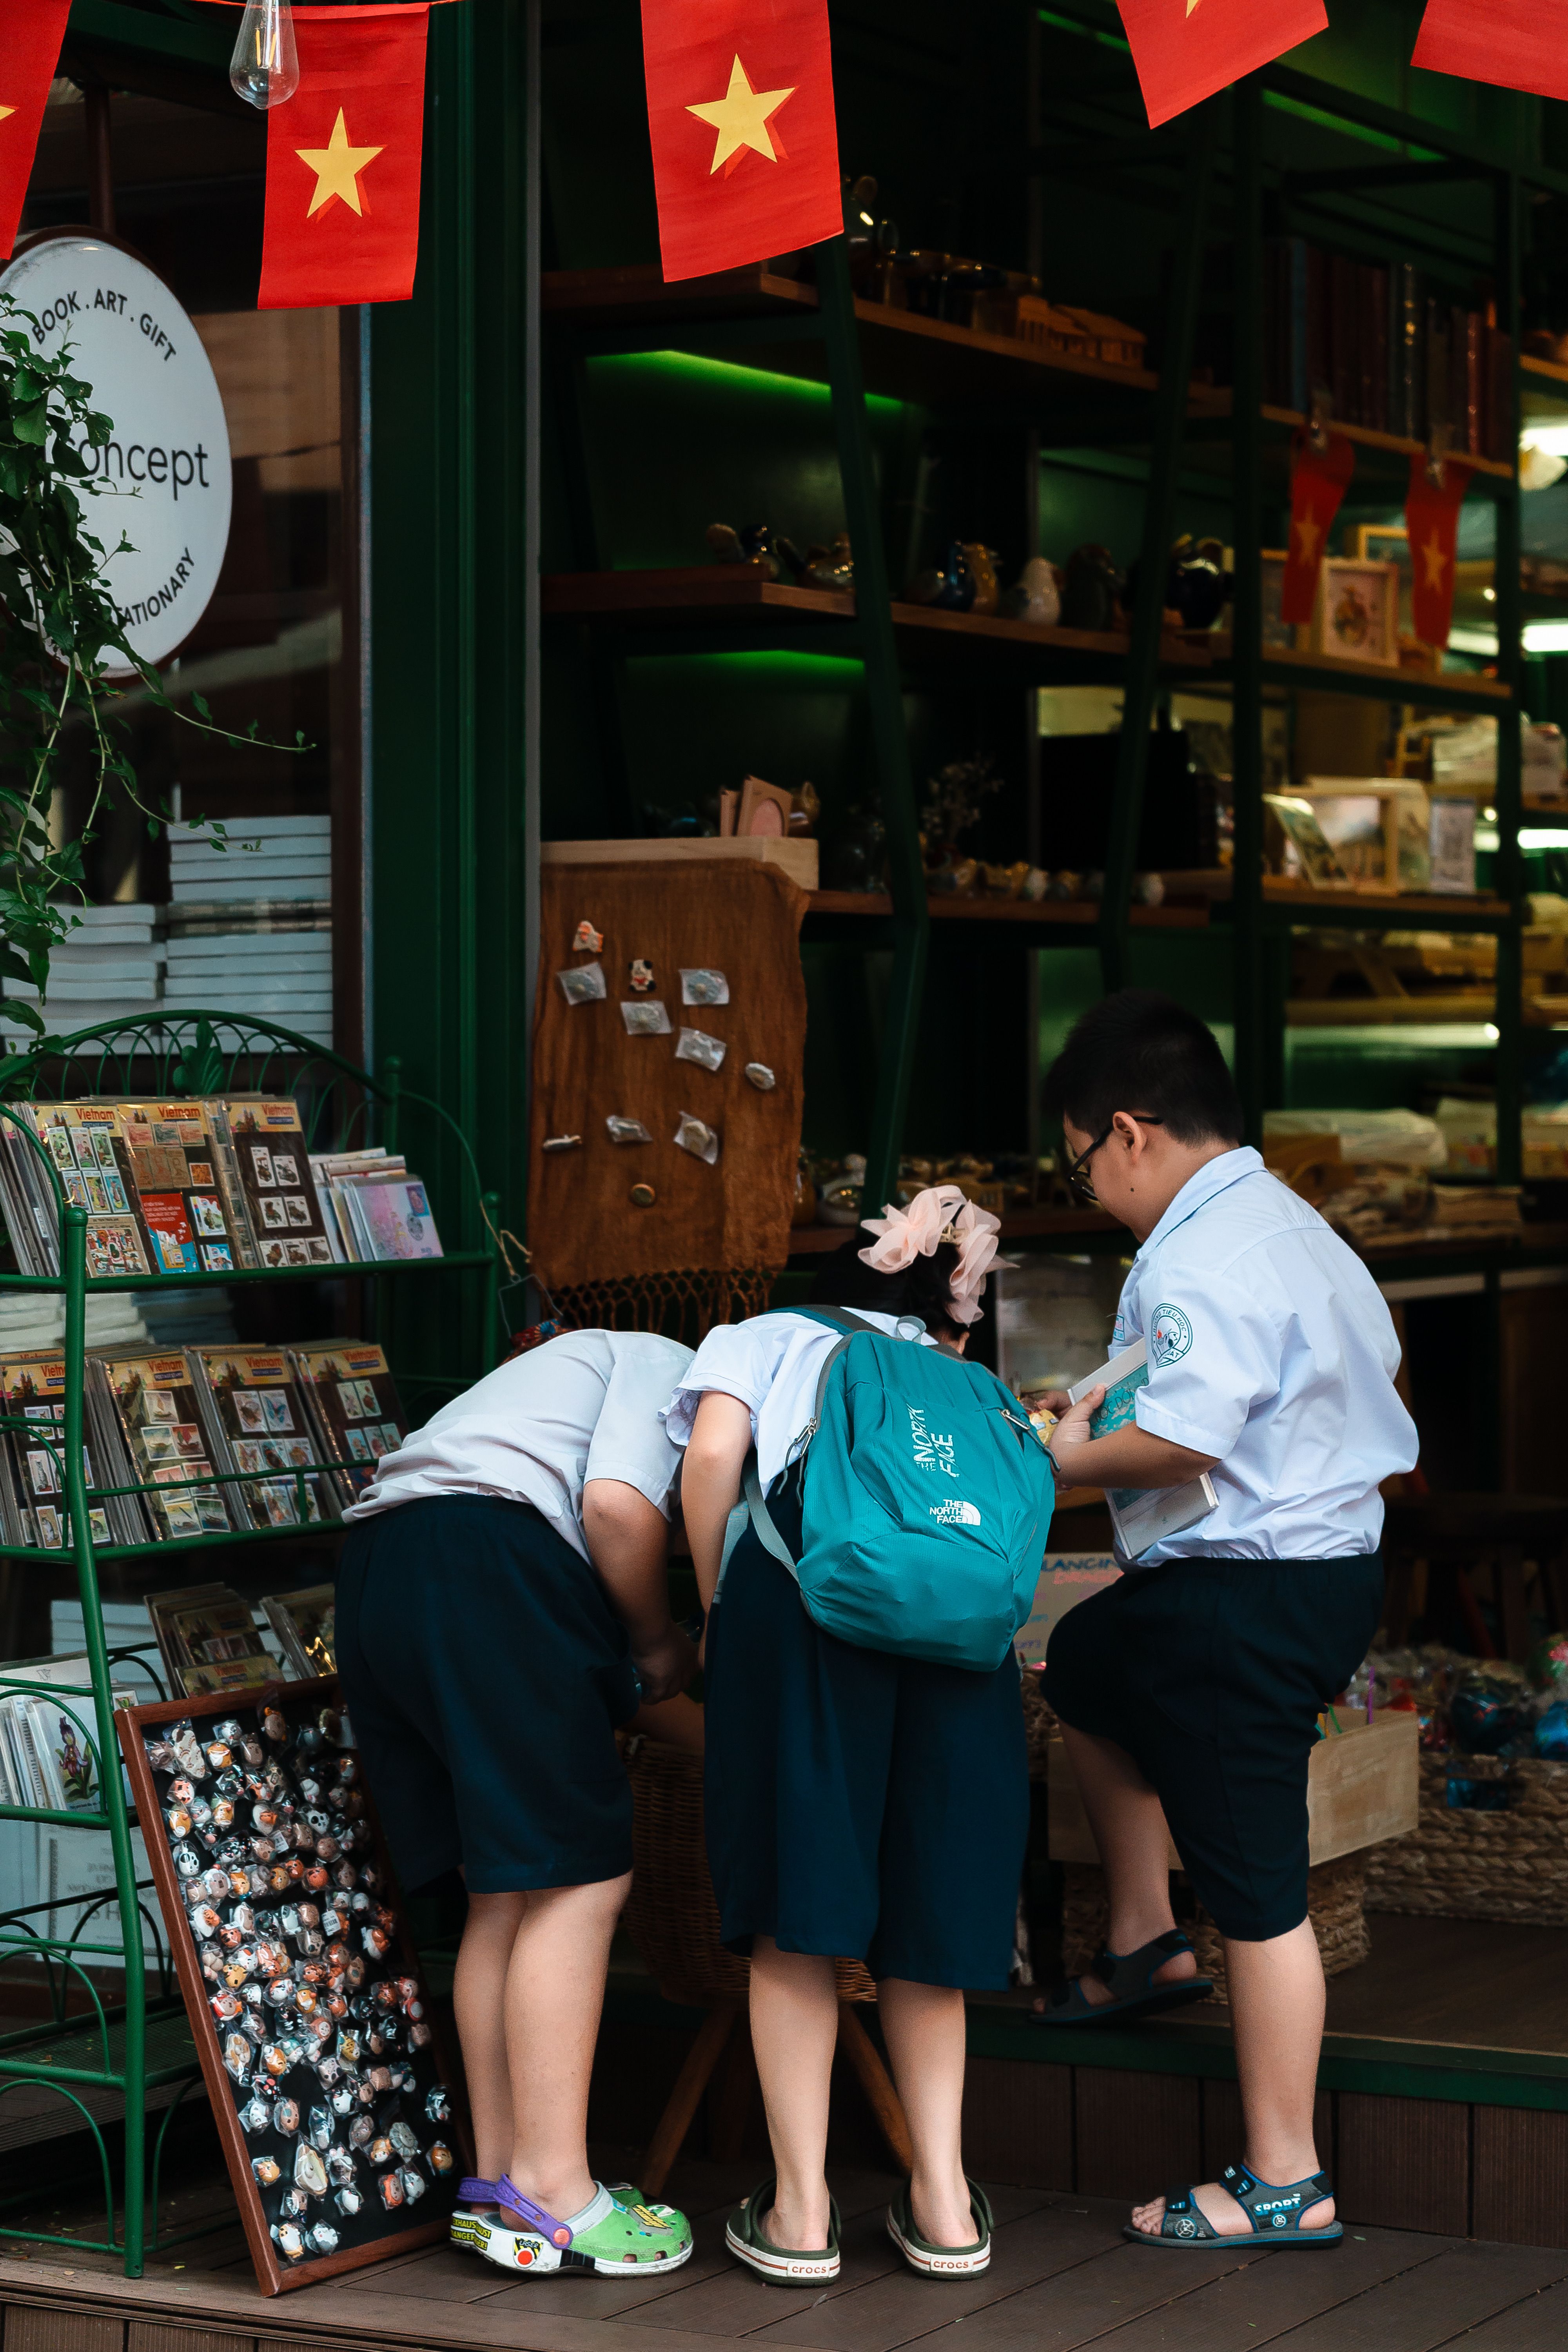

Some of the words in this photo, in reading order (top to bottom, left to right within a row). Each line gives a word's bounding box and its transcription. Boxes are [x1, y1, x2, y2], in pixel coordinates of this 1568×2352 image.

[32, 290, 81, 345] BOOK
[94, 289, 127, 315] ART
[140, 314, 176, 361] GIFT
[68, 436, 209, 501] oncept
[118, 547, 194, 626] ATIONARY
[75, 1108, 116, 1120] Vietnam
[158, 1106, 201, 1118] Vietnam
[906, 1403, 936, 1462] NORTH
[930, 1433, 960, 1477] FACE
[929, 1506, 963, 1515] NORTH
[943, 1499, 963, 1508] THE
[936, 1515, 962, 1524] FACE
[1255, 2196, 1301, 2216] SPORT
[934, 2261, 969, 2269] crocs
